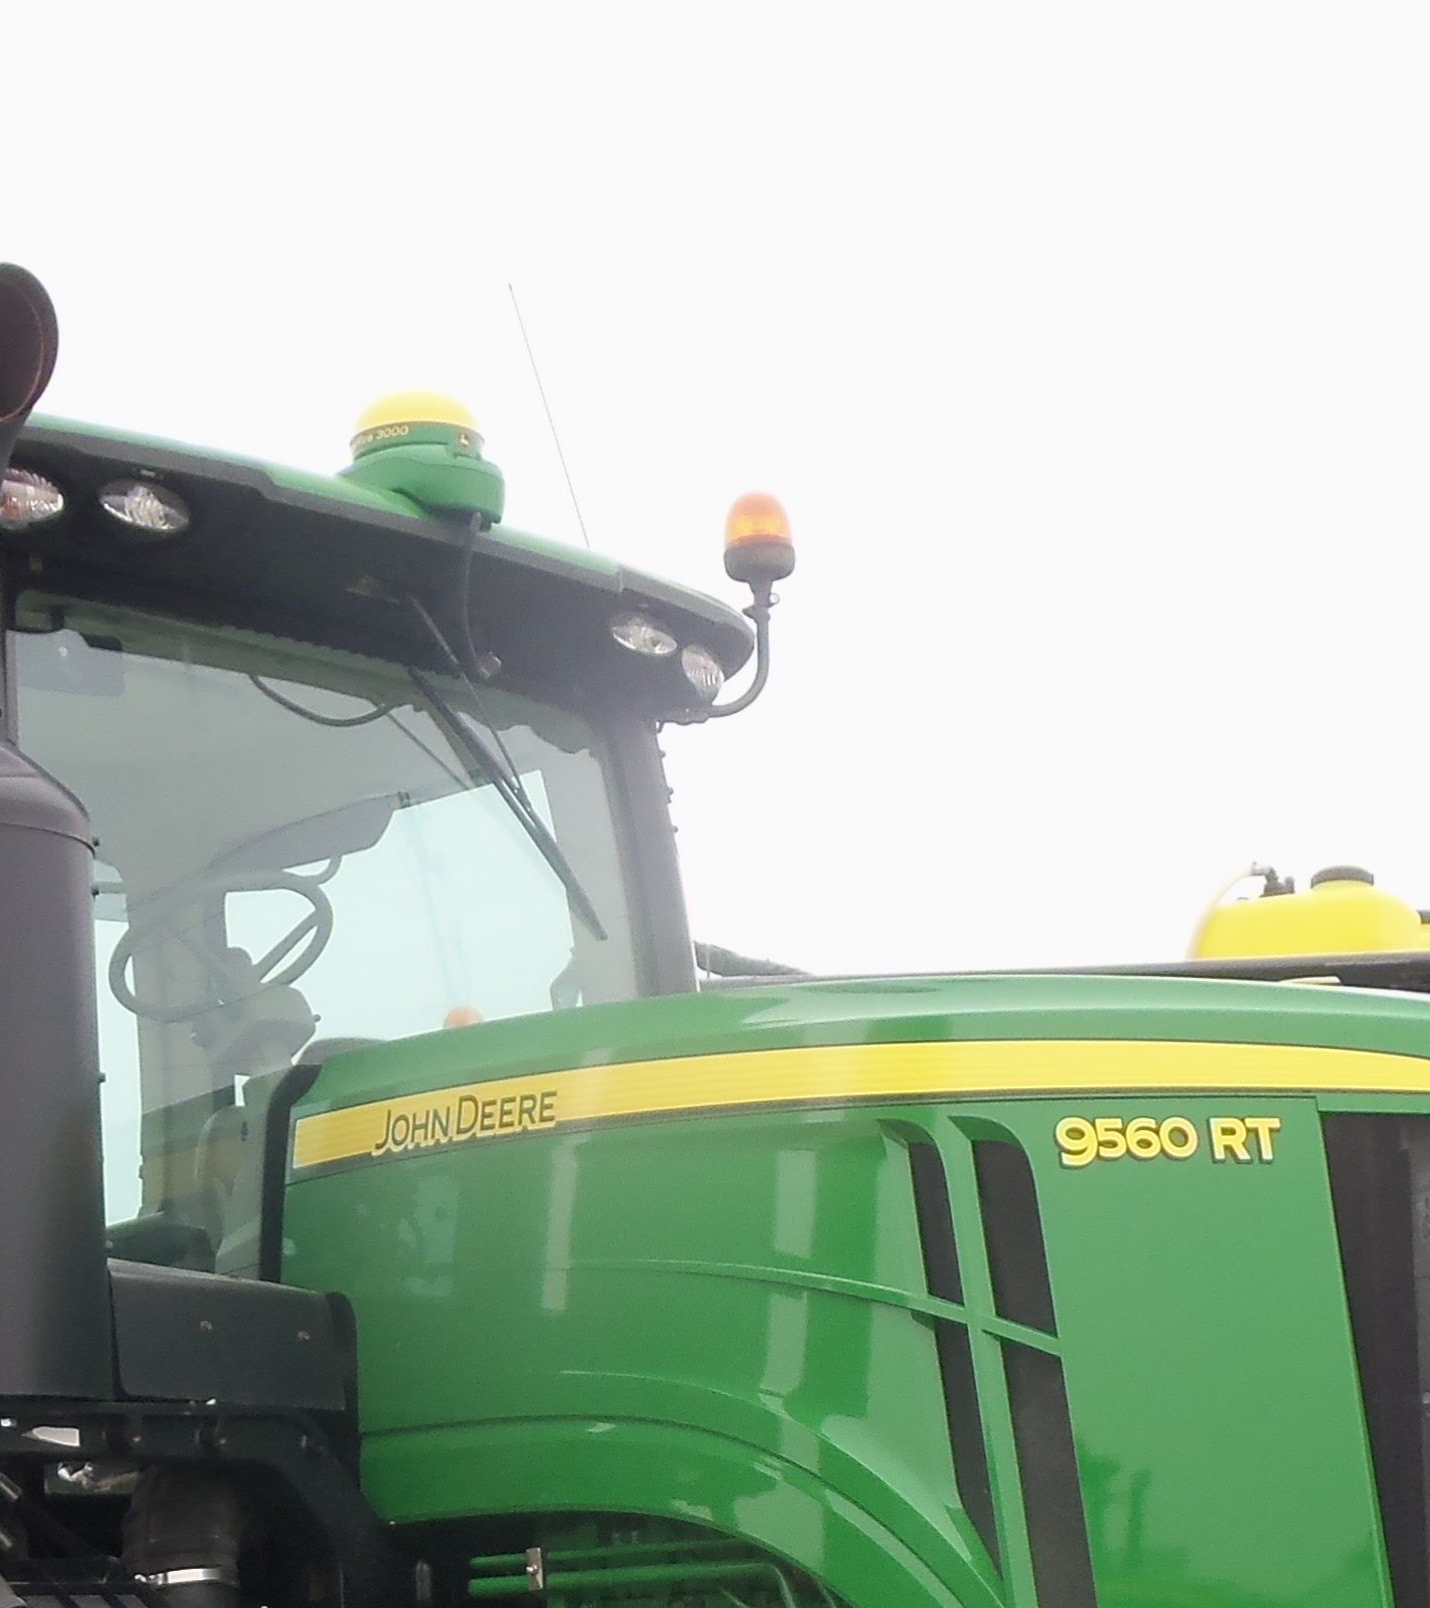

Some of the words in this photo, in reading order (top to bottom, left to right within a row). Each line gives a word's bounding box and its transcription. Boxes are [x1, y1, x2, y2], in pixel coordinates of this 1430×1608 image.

[375, 425, 409, 440] 3000
[374, 1106, 451, 1151] JOHN
[456, 1091, 558, 1136] DEERE
[1055, 1116, 1199, 1167] 9560
[1209, 1117, 1282, 1162] RT
